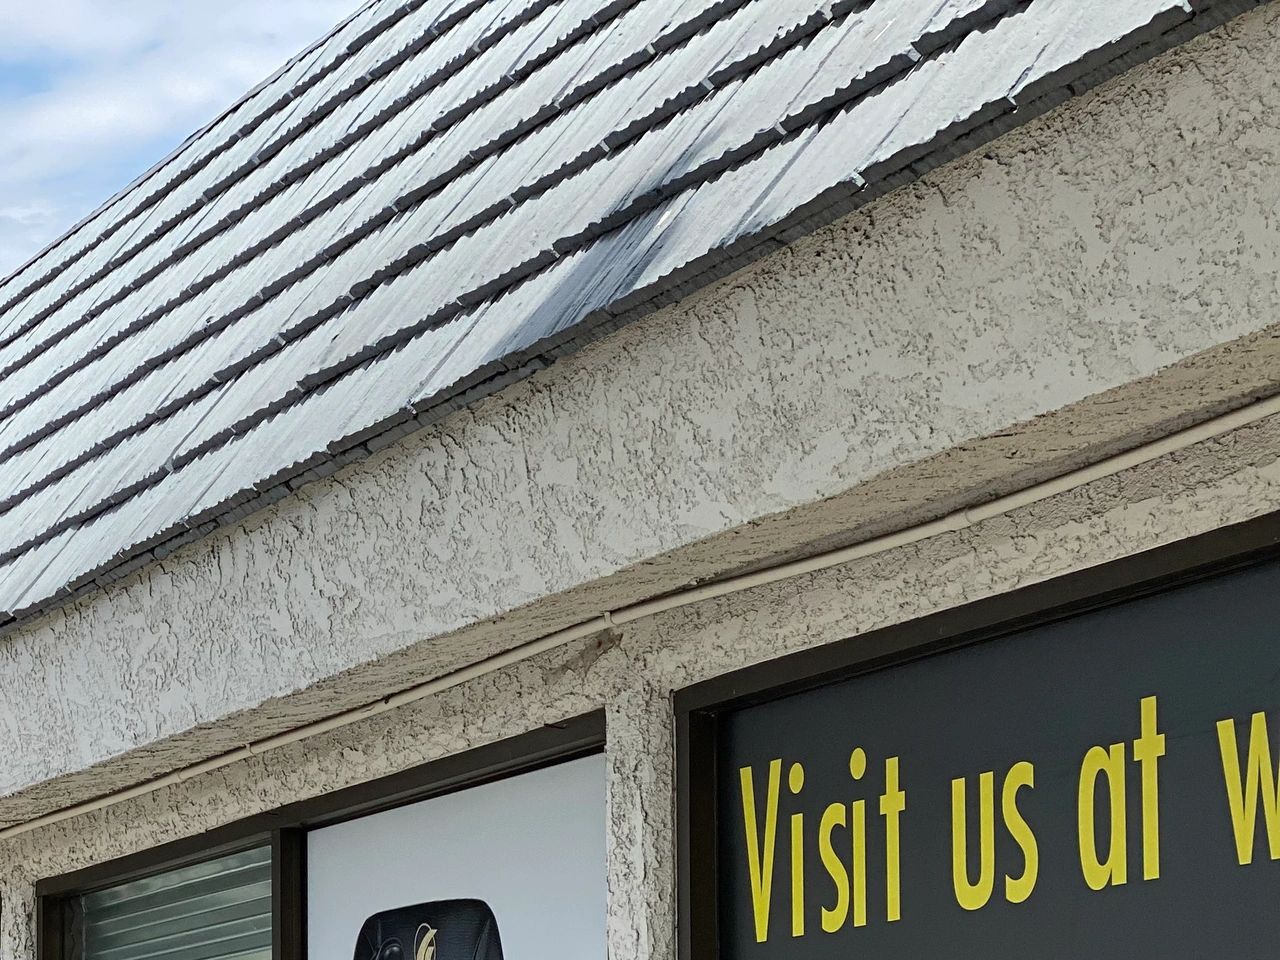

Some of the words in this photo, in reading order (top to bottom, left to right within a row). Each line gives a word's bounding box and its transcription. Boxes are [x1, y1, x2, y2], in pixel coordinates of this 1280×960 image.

[740, 747, 906, 943] Visit
[951, 761, 1040, 911] us
[1078, 695, 1166, 891] at
